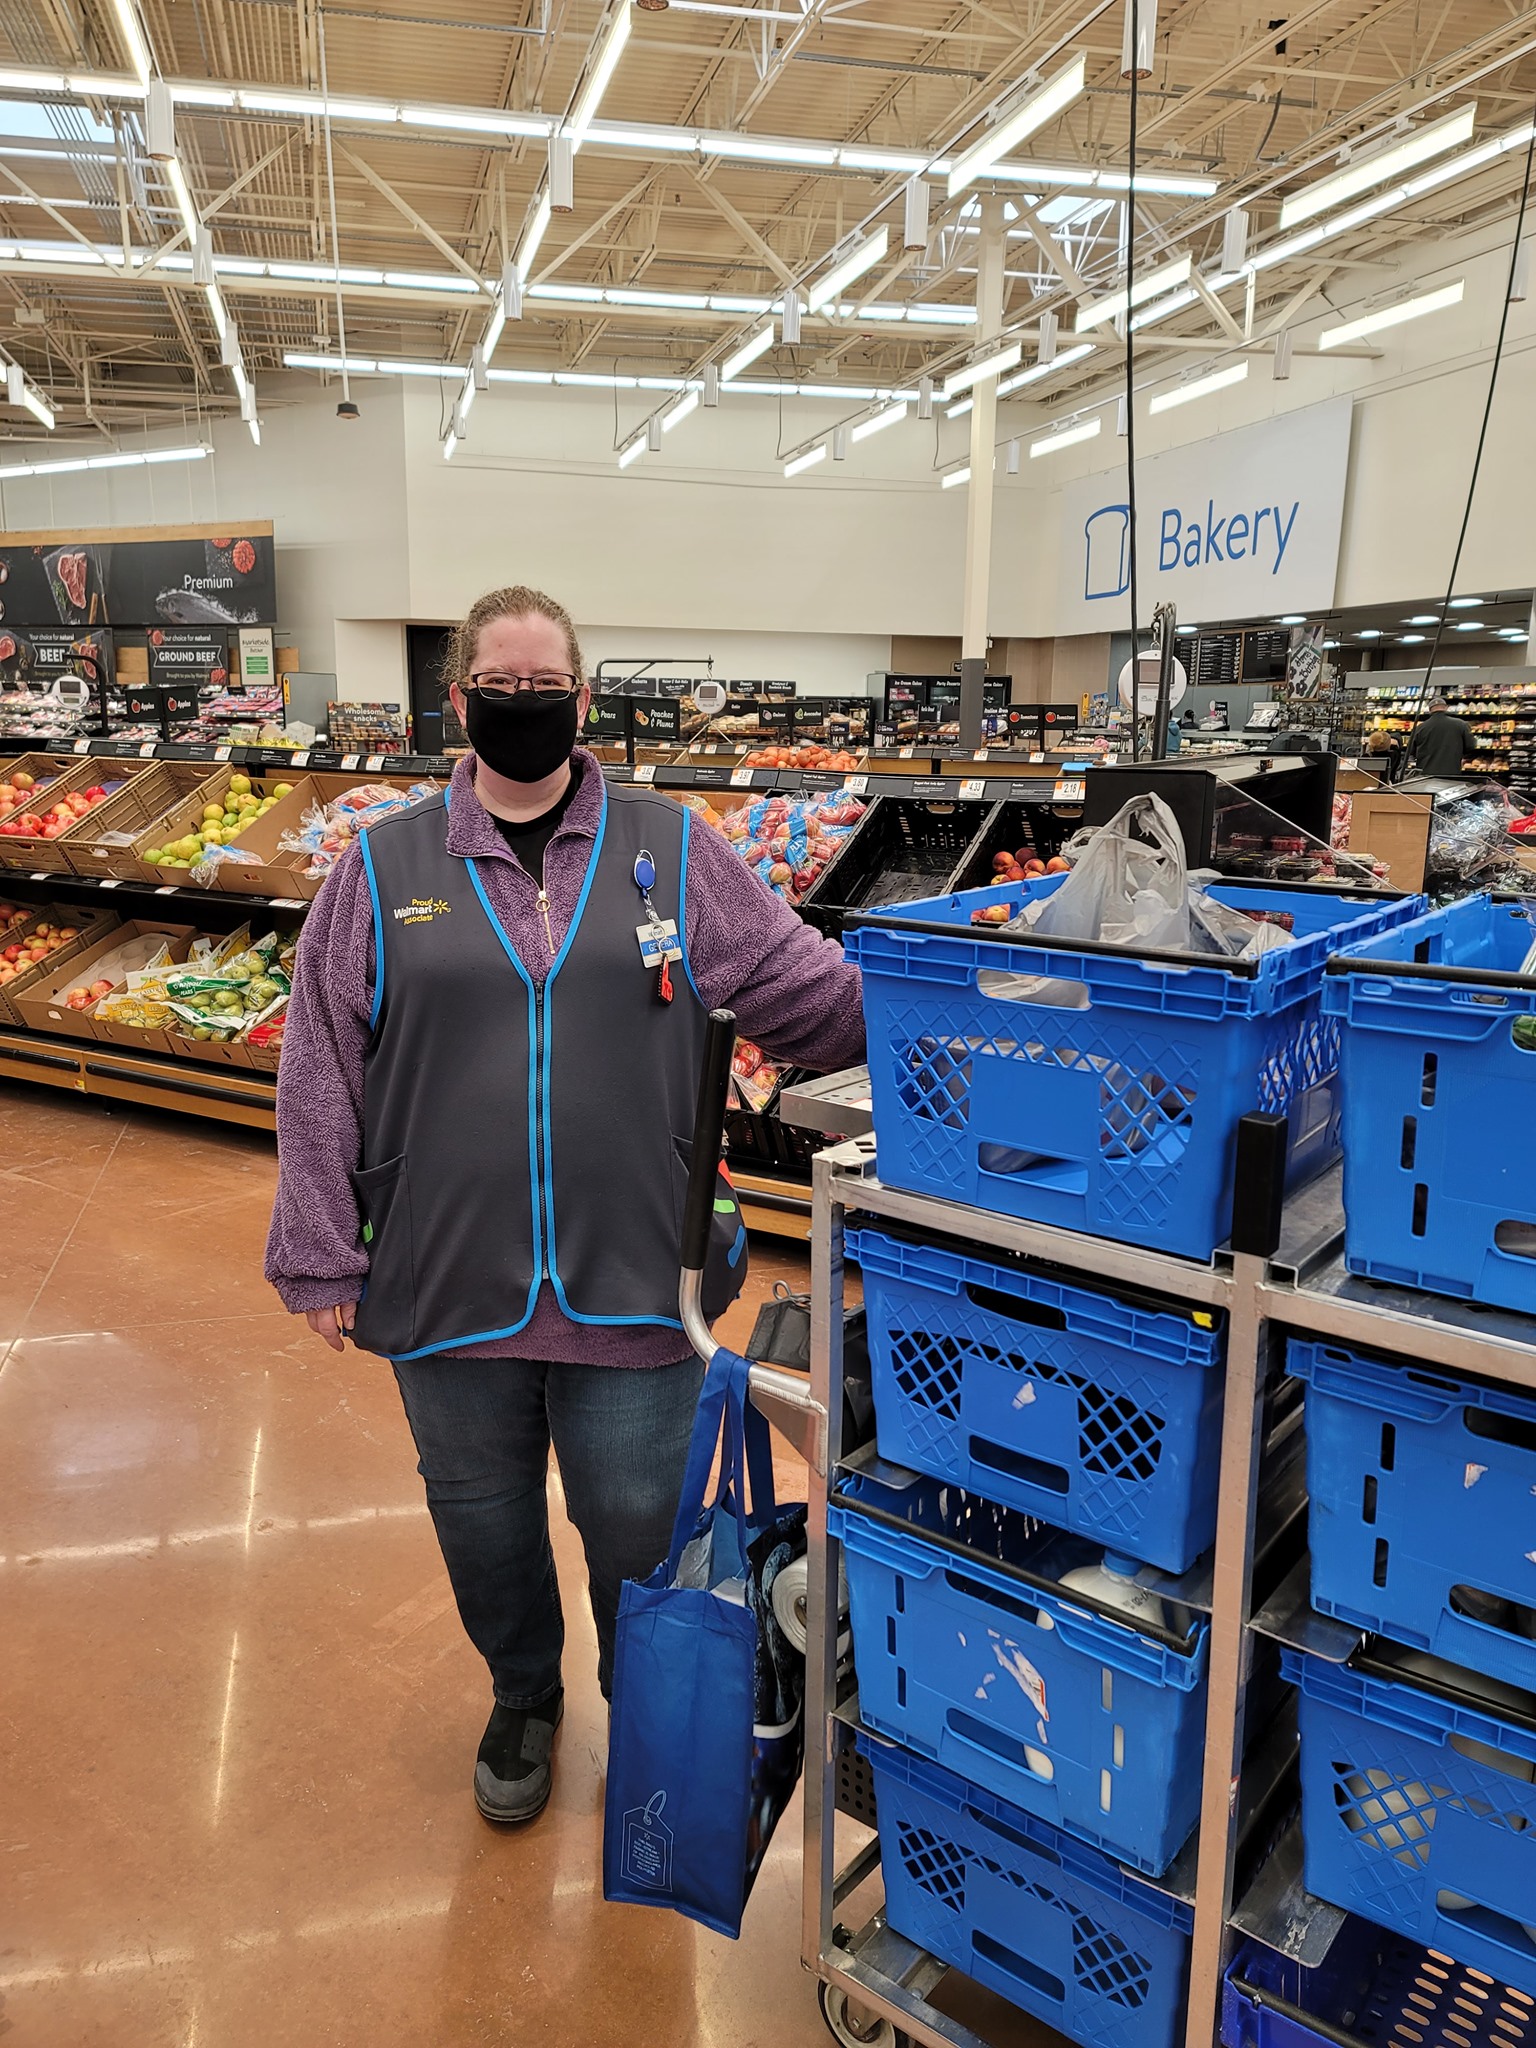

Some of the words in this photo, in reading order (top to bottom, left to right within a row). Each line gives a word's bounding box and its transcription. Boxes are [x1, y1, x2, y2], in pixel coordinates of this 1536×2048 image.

[1159, 499, 1300, 575] Bakery
[184, 574, 233, 589] Premium
[195, 634, 211, 642] natural
[159, 651, 195, 662] GROUND
[196, 651, 216, 662] BEEF
[141, 702, 155, 711] Apples
[178, 700, 191, 708] Apples
[344, 706, 385, 716] Wholesome
[600, 710, 616, 719] Pears
[650, 709, 674, 718] Peaches
[656, 718, 674, 728] Plums
[411, 896, 434, 907] Proud
[393, 904, 433, 920] Walmart
[403, 914, 434, 926] Associate
